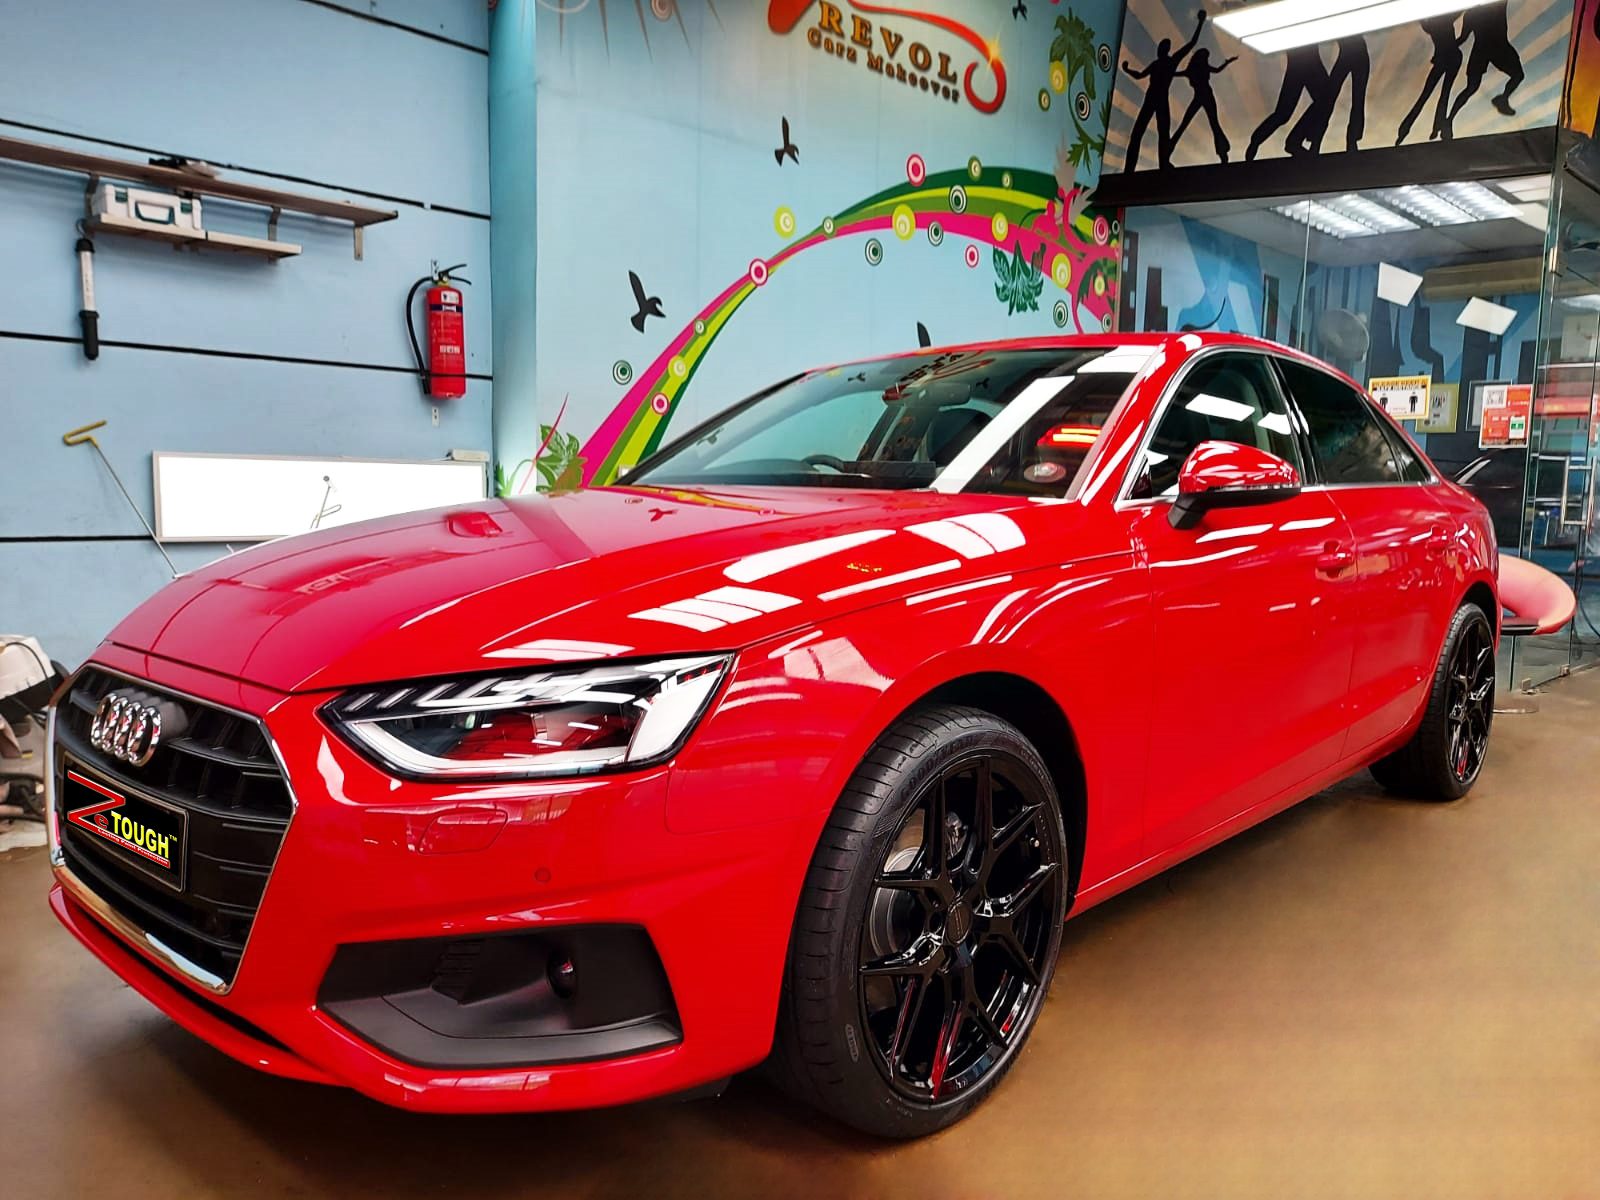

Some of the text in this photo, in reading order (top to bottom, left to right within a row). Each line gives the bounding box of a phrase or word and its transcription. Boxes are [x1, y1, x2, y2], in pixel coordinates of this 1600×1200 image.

[818, 0, 958, 85] REVOL
[866, 51, 960, 104] Makeover
[110, 810, 169, 859] TOUGH
